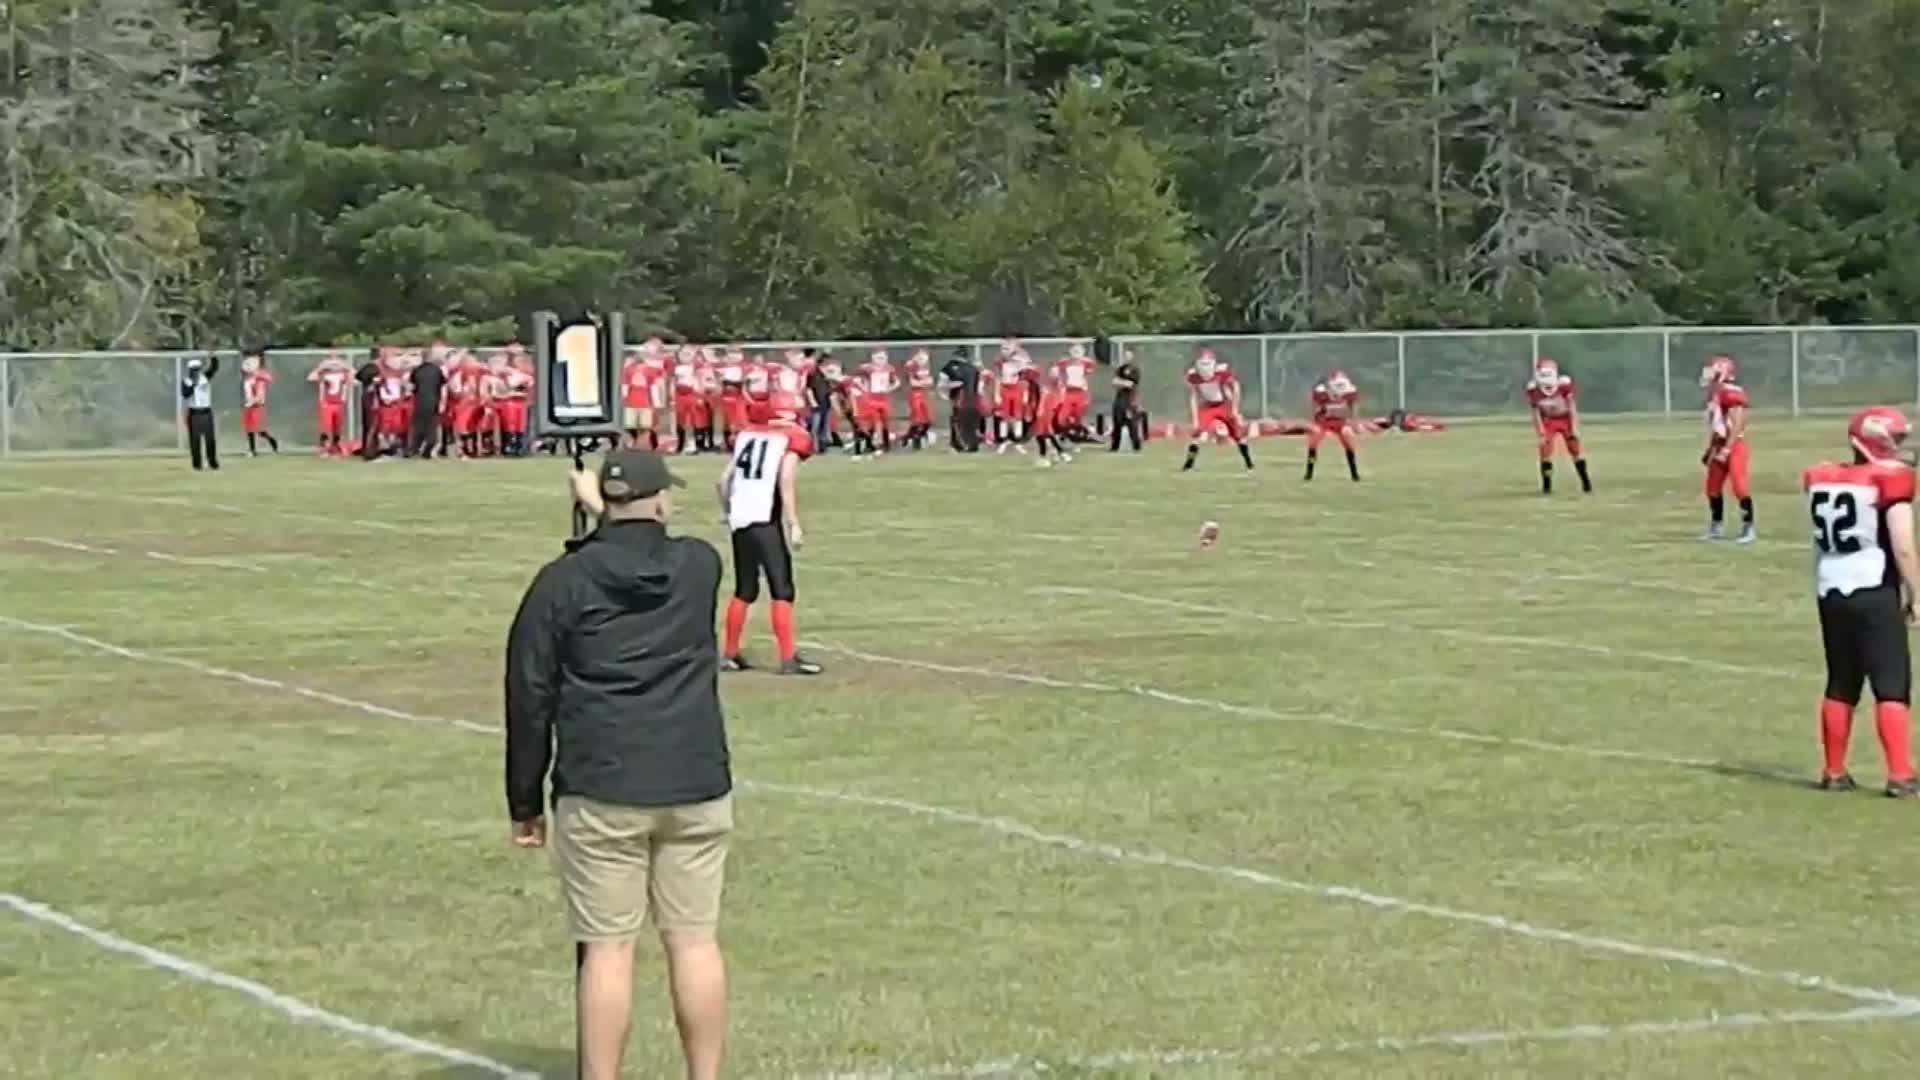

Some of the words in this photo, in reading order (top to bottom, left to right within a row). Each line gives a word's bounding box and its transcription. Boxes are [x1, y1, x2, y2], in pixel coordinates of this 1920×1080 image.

[553, 324, 602, 417] 1
[736, 439, 769, 480] 41
[1811, 491, 1861, 554] 52
